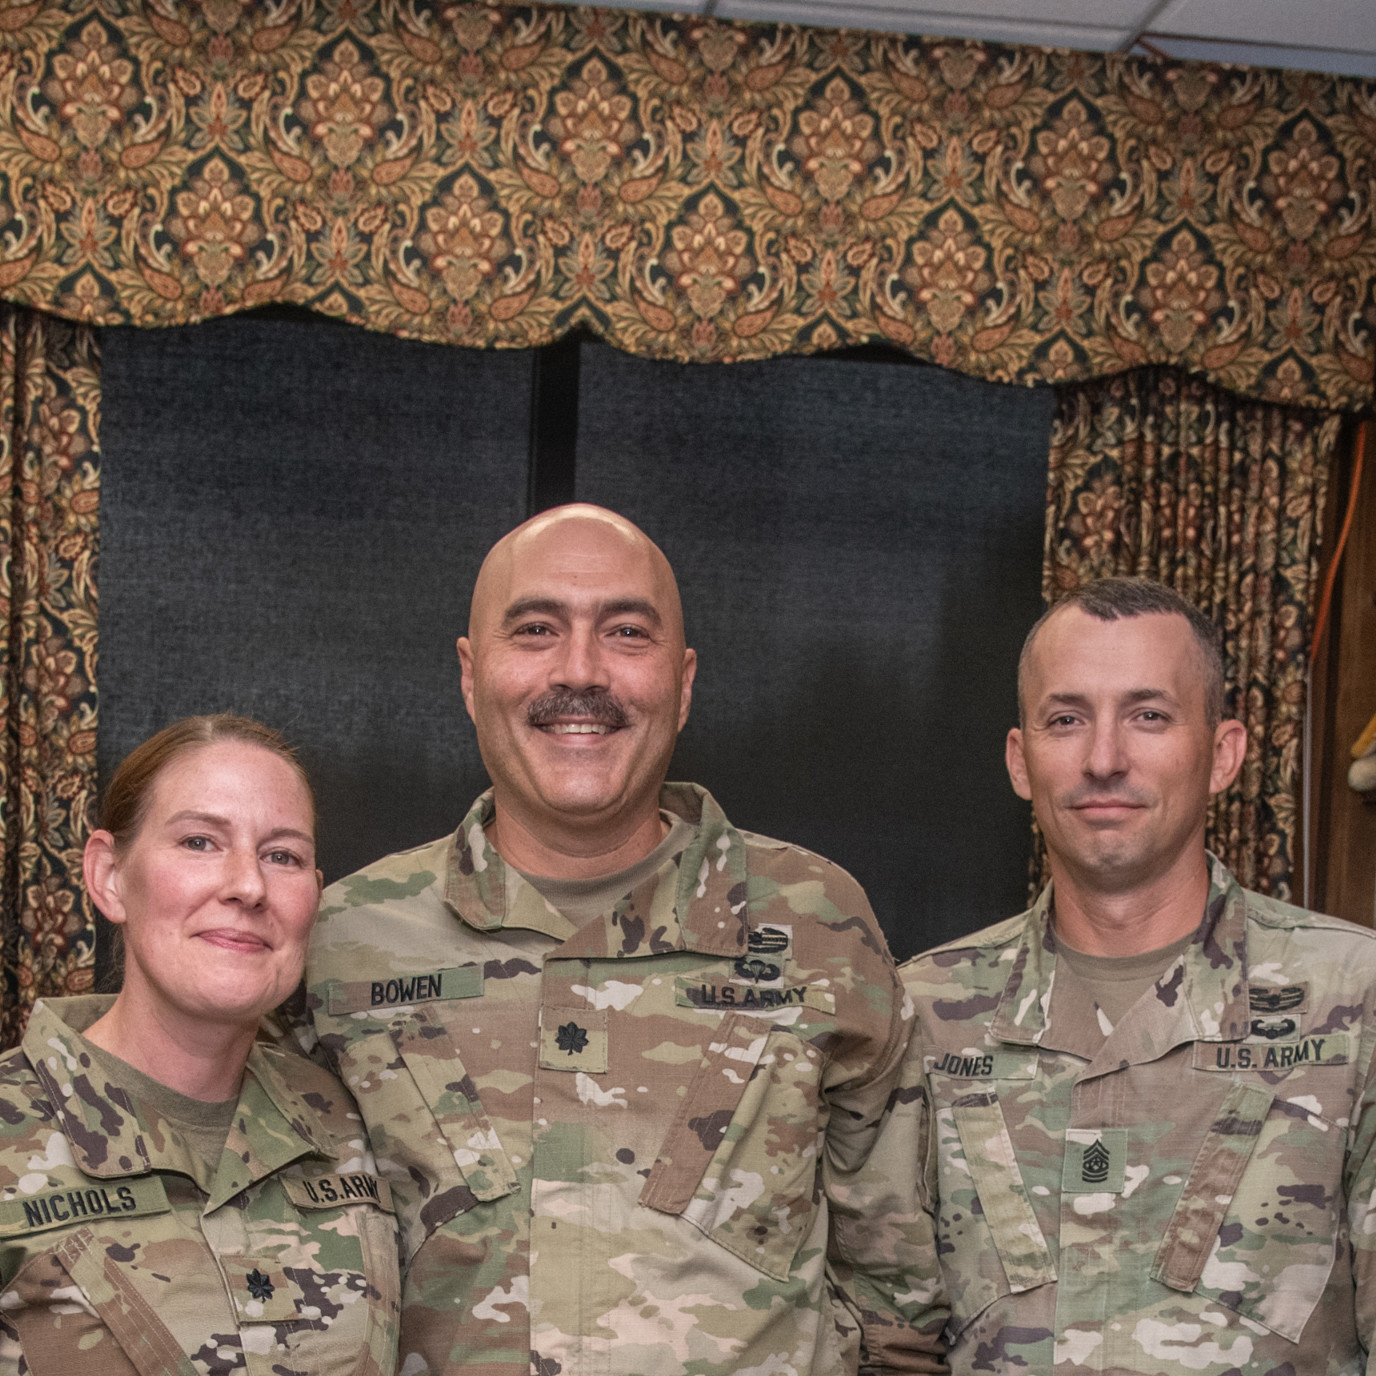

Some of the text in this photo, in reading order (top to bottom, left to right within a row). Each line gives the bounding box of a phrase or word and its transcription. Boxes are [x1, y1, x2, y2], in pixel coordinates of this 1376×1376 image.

[371, 973, 442, 1006] BOWEN
[744, 986, 808, 1008] ARMY
[933, 1053, 994, 1077] JONES
[1216, 1038, 1326, 1069] U.S. ARMY
[22, 1186, 137, 1227] NICHOLS
